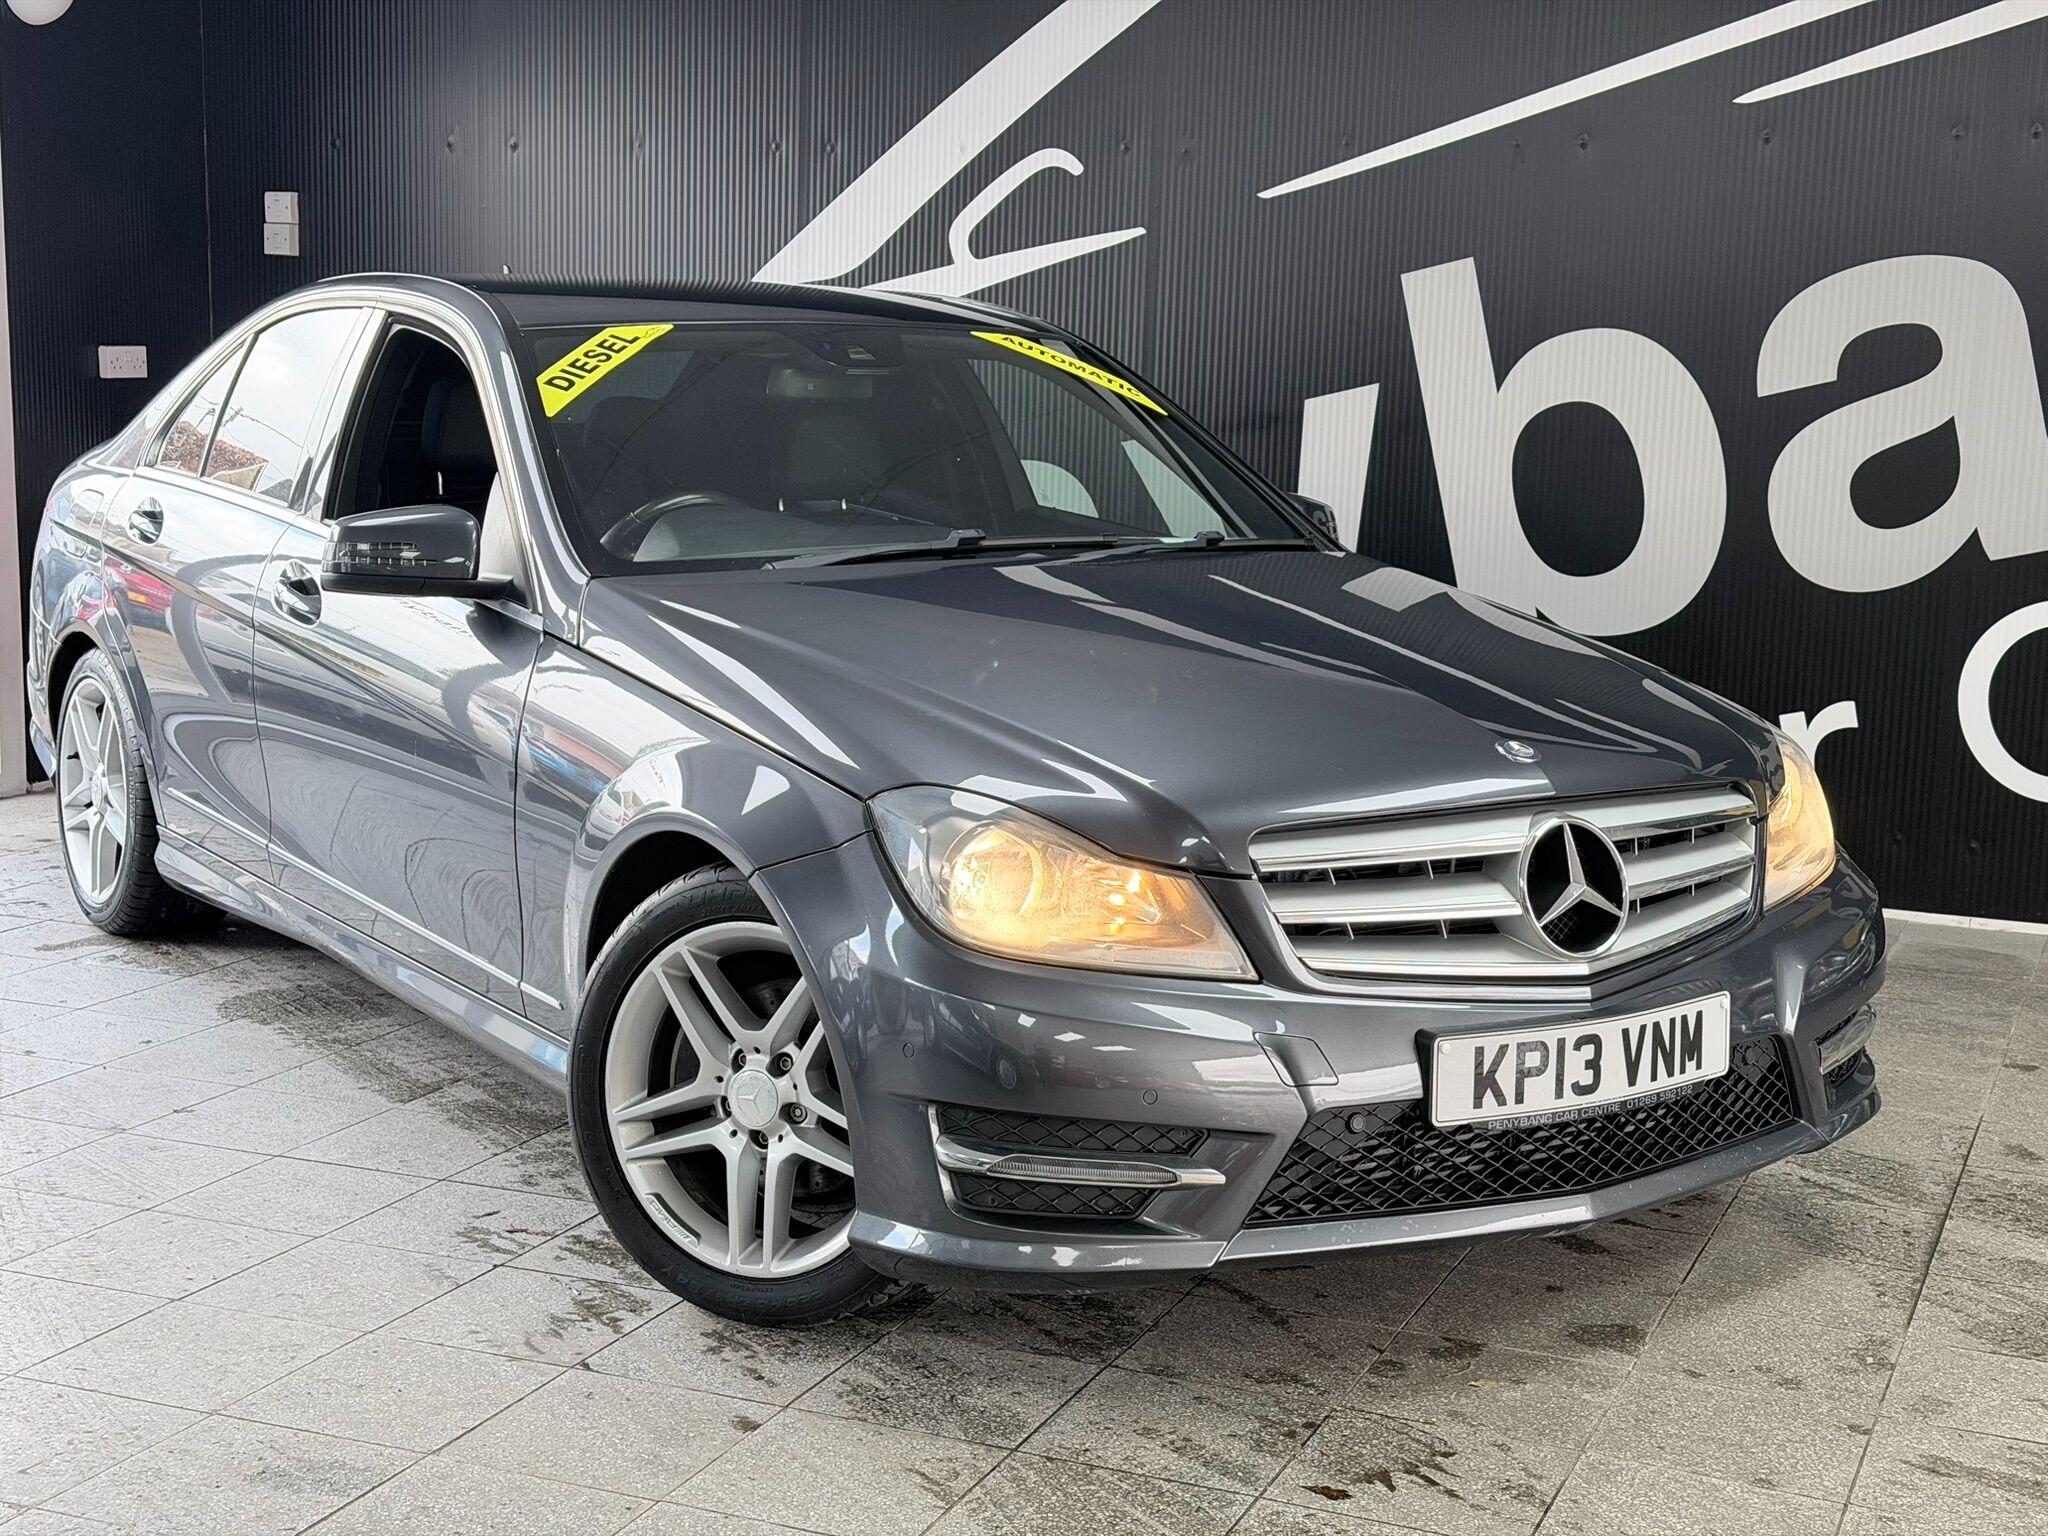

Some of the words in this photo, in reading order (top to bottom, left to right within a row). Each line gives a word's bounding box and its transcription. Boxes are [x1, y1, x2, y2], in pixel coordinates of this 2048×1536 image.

[543, 333, 642, 392] DIESEL
[1001, 336, 1141, 397] AUTOMATIC
[1472, 1033, 1603, 1110] KP13
[1621, 1009, 1704, 1088] VNM
[1556, 1110, 1578, 1121] CAR
[1581, 1103, 1621, 1117] CENTRE
[1626, 1094, 1657, 1109] 01269
[1659, 1084, 1693, 1101] 592122
